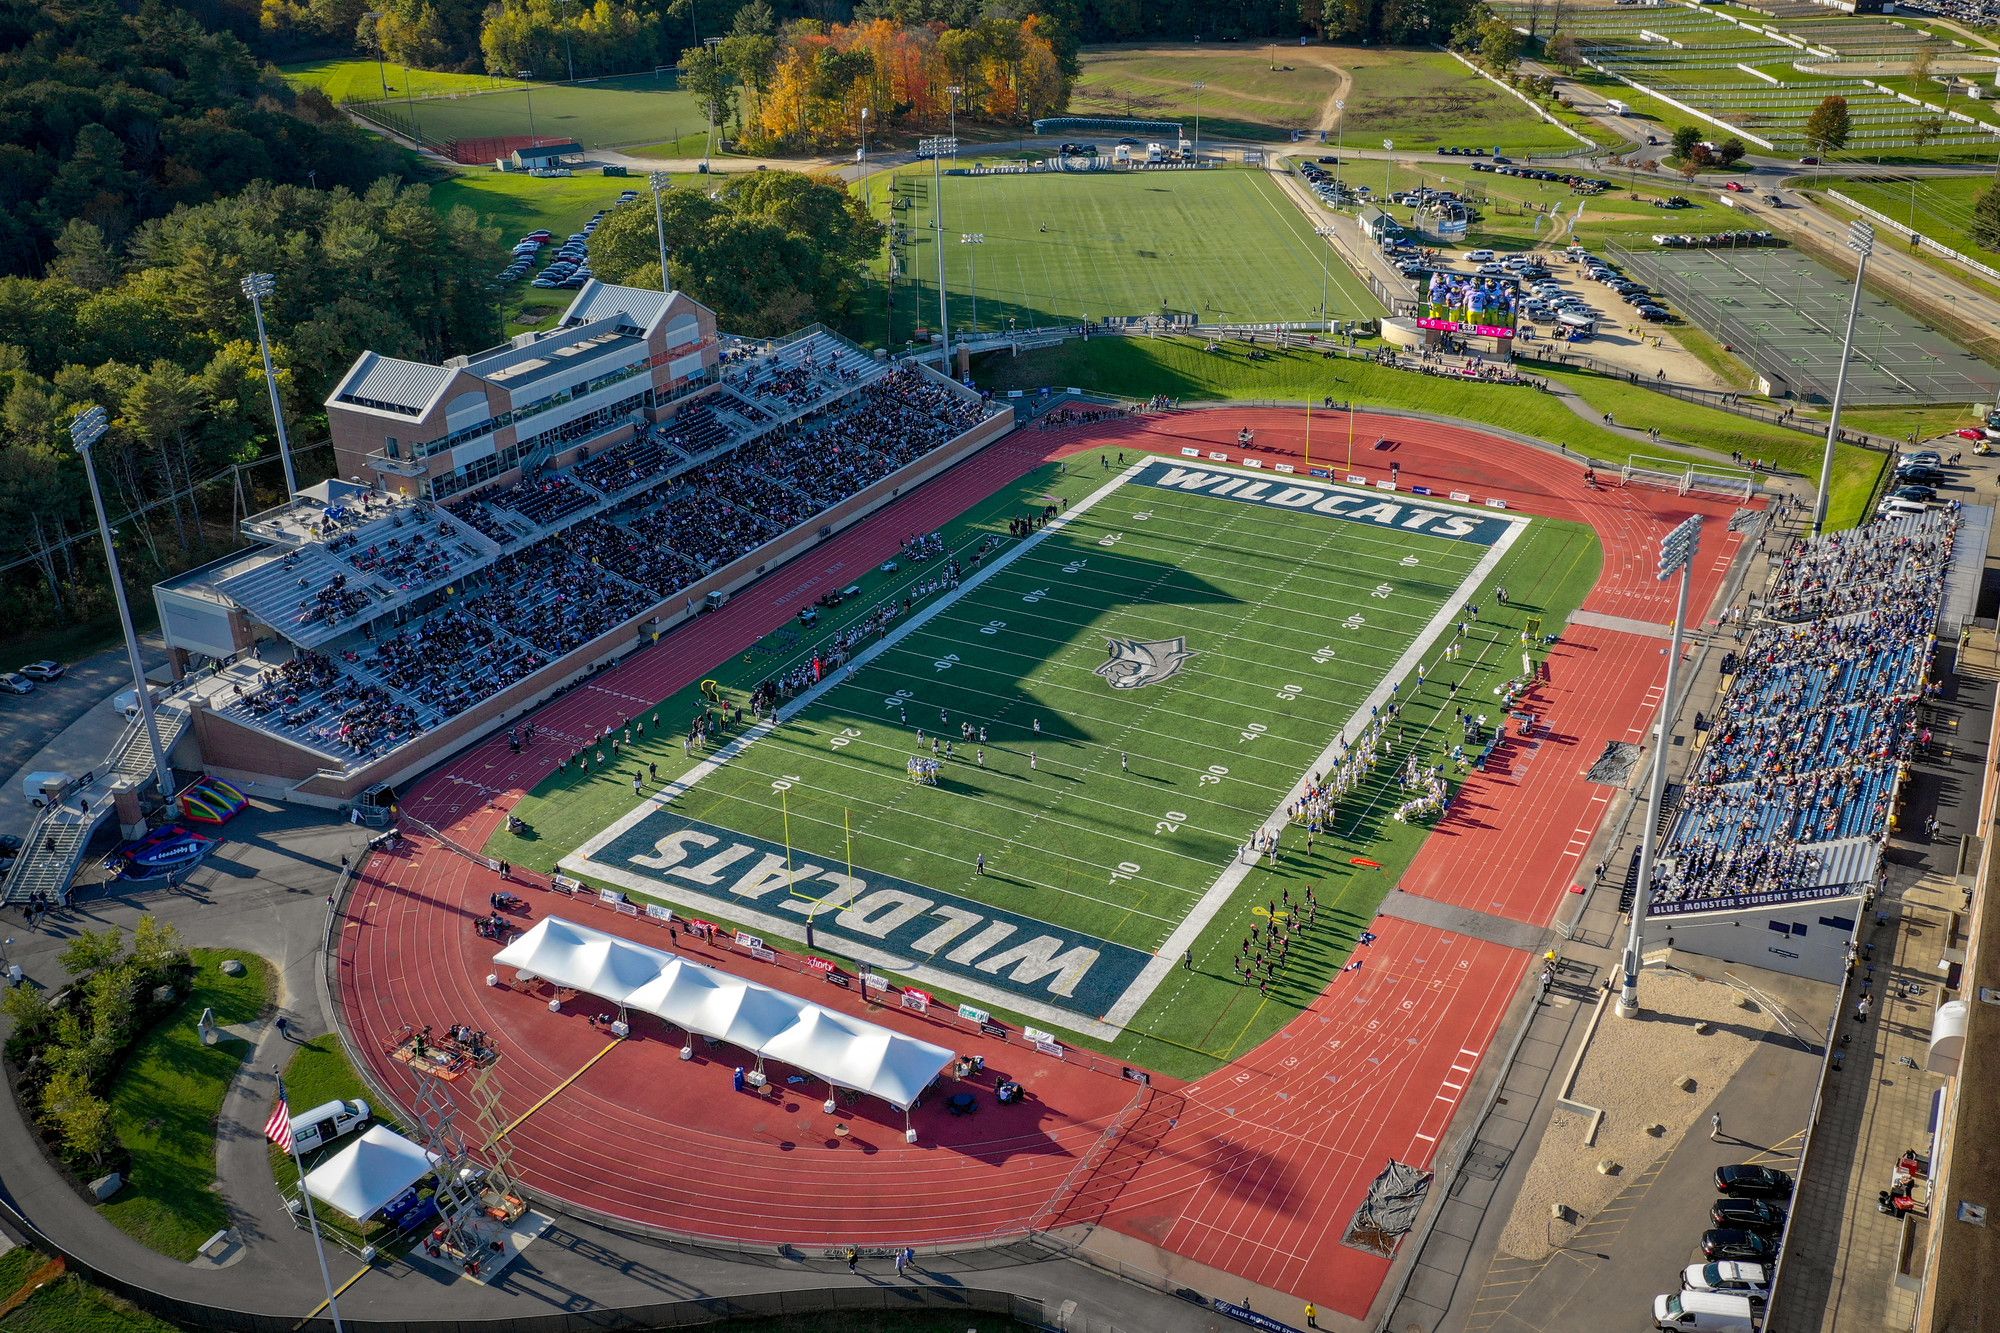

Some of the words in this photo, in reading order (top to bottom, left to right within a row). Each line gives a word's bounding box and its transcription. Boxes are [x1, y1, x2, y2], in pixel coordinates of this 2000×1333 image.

[1156, 467, 1484, 536] WILDCATS
[1133, 511, 1152, 521] 10
[1099, 533, 1122, 546] 20
[1062, 559, 1087, 574] 30
[1399, 555, 1419, 567] 10
[1023, 588, 1049, 603] 40
[1371, 584, 1393, 599] 20
[980, 620, 1007, 634] 50
[1342, 613, 1366, 630] 30
[934, 653, 960, 670] 40
[1311, 646, 1336, 664] 40
[884, 689, 914, 707] 30
[1276, 684, 1303, 701] 50
[829, 728, 862, 748] 20
[1242, 723, 1268, 741] 40
[1201, 765, 1229, 785] 30
[771, 775, 801, 792] 10
[1158, 811, 1187, 833] 20
[1113, 862, 1140, 882] 10
[1653, 903, 1680, 914] BLUE
[1684, 899, 1735, 910] MONSTER
[1739, 893, 1788, 905] STUDENT
[1792, 887, 1840, 900] SECTION
[628, 829, 1101, 998] WILDCATS
[807, 958, 834, 971] xfinity
[1458, 960, 1470, 970] 8
[1432, 980, 1443, 988] 7
[1402, 1000, 1414, 1010] 6
[1367, 1020, 1380, 1030] 5
[1329, 1040, 1340, 1049] 4
[1284, 1057, 1298, 1066] 3
[1236, 1073, 1250, 1083] 2
[1188, 1086, 1201, 1094] 1
[1231, 1309, 1249, 1319] BLUE
